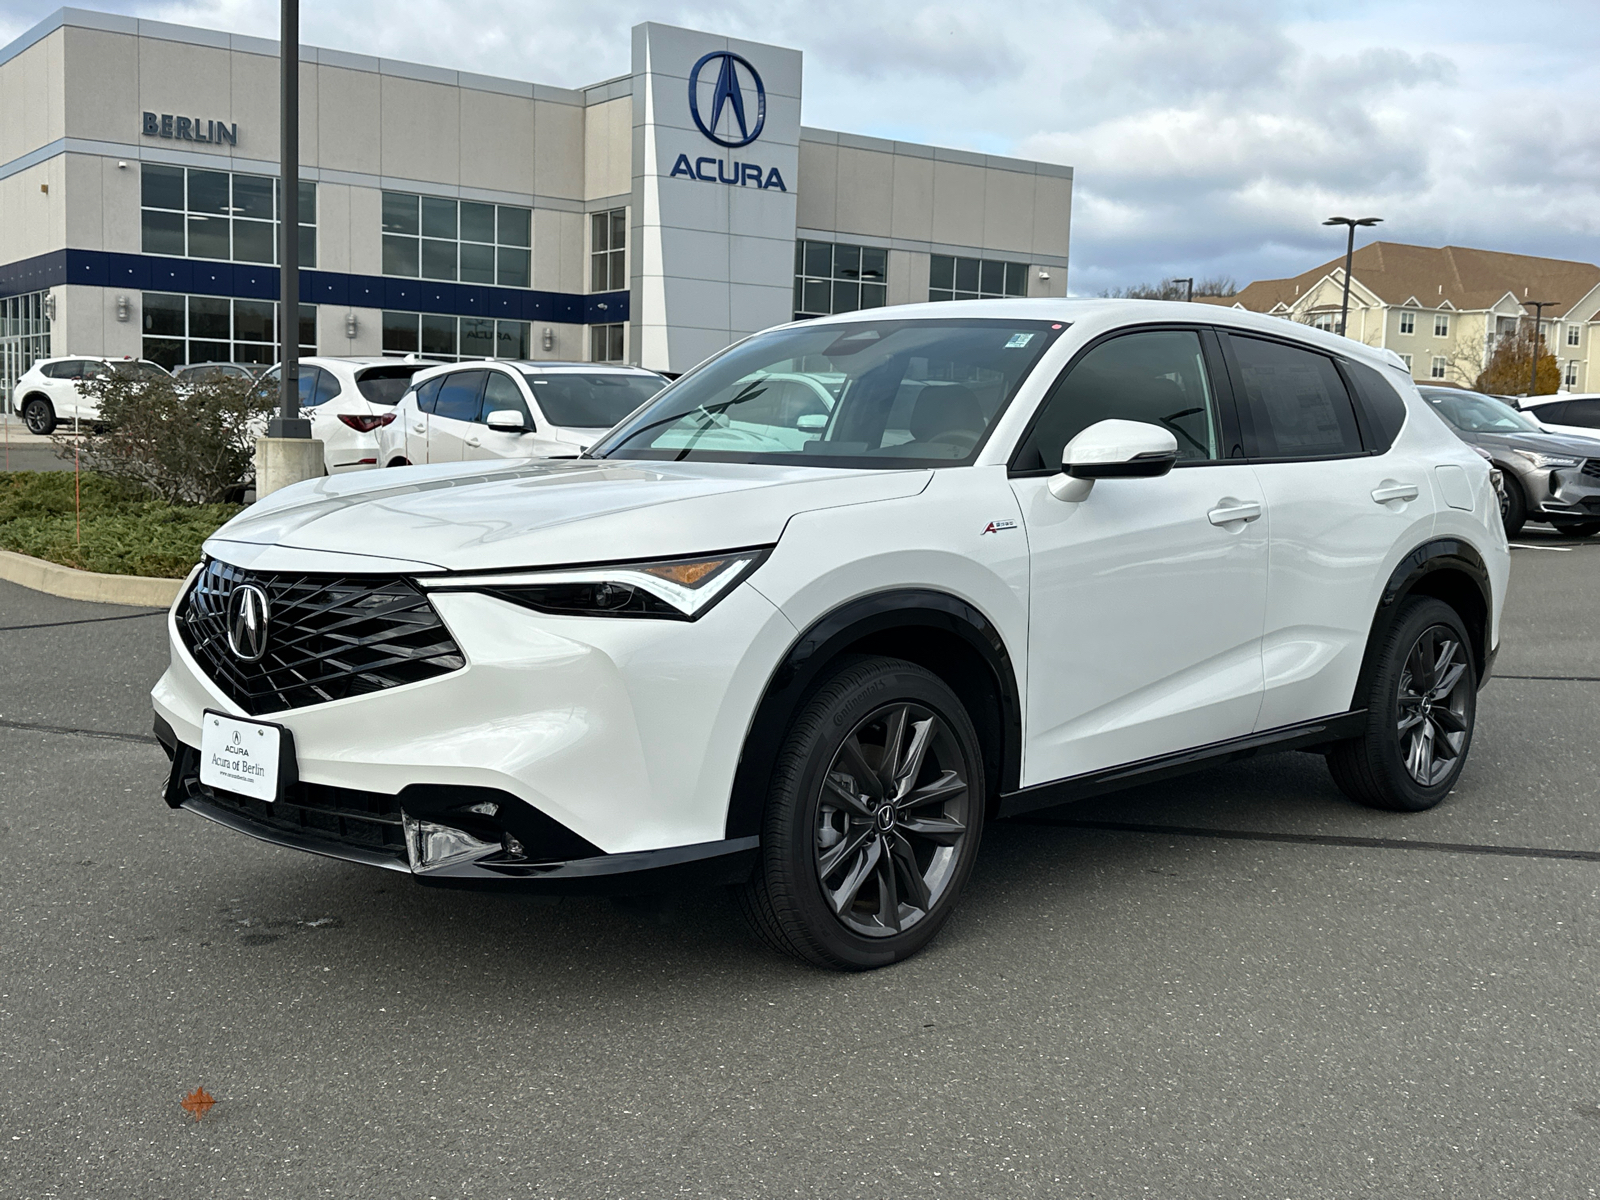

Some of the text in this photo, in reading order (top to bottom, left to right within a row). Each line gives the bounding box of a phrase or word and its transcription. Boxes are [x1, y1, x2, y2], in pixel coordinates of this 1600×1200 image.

[142, 111, 238, 146] BERLIN
[670, 153, 787, 192] ACURA
[833, 682, 881, 727] Continental
[212, 753, 265, 777] Acura of Berlin
[225, 745, 249, 756] ACURA
